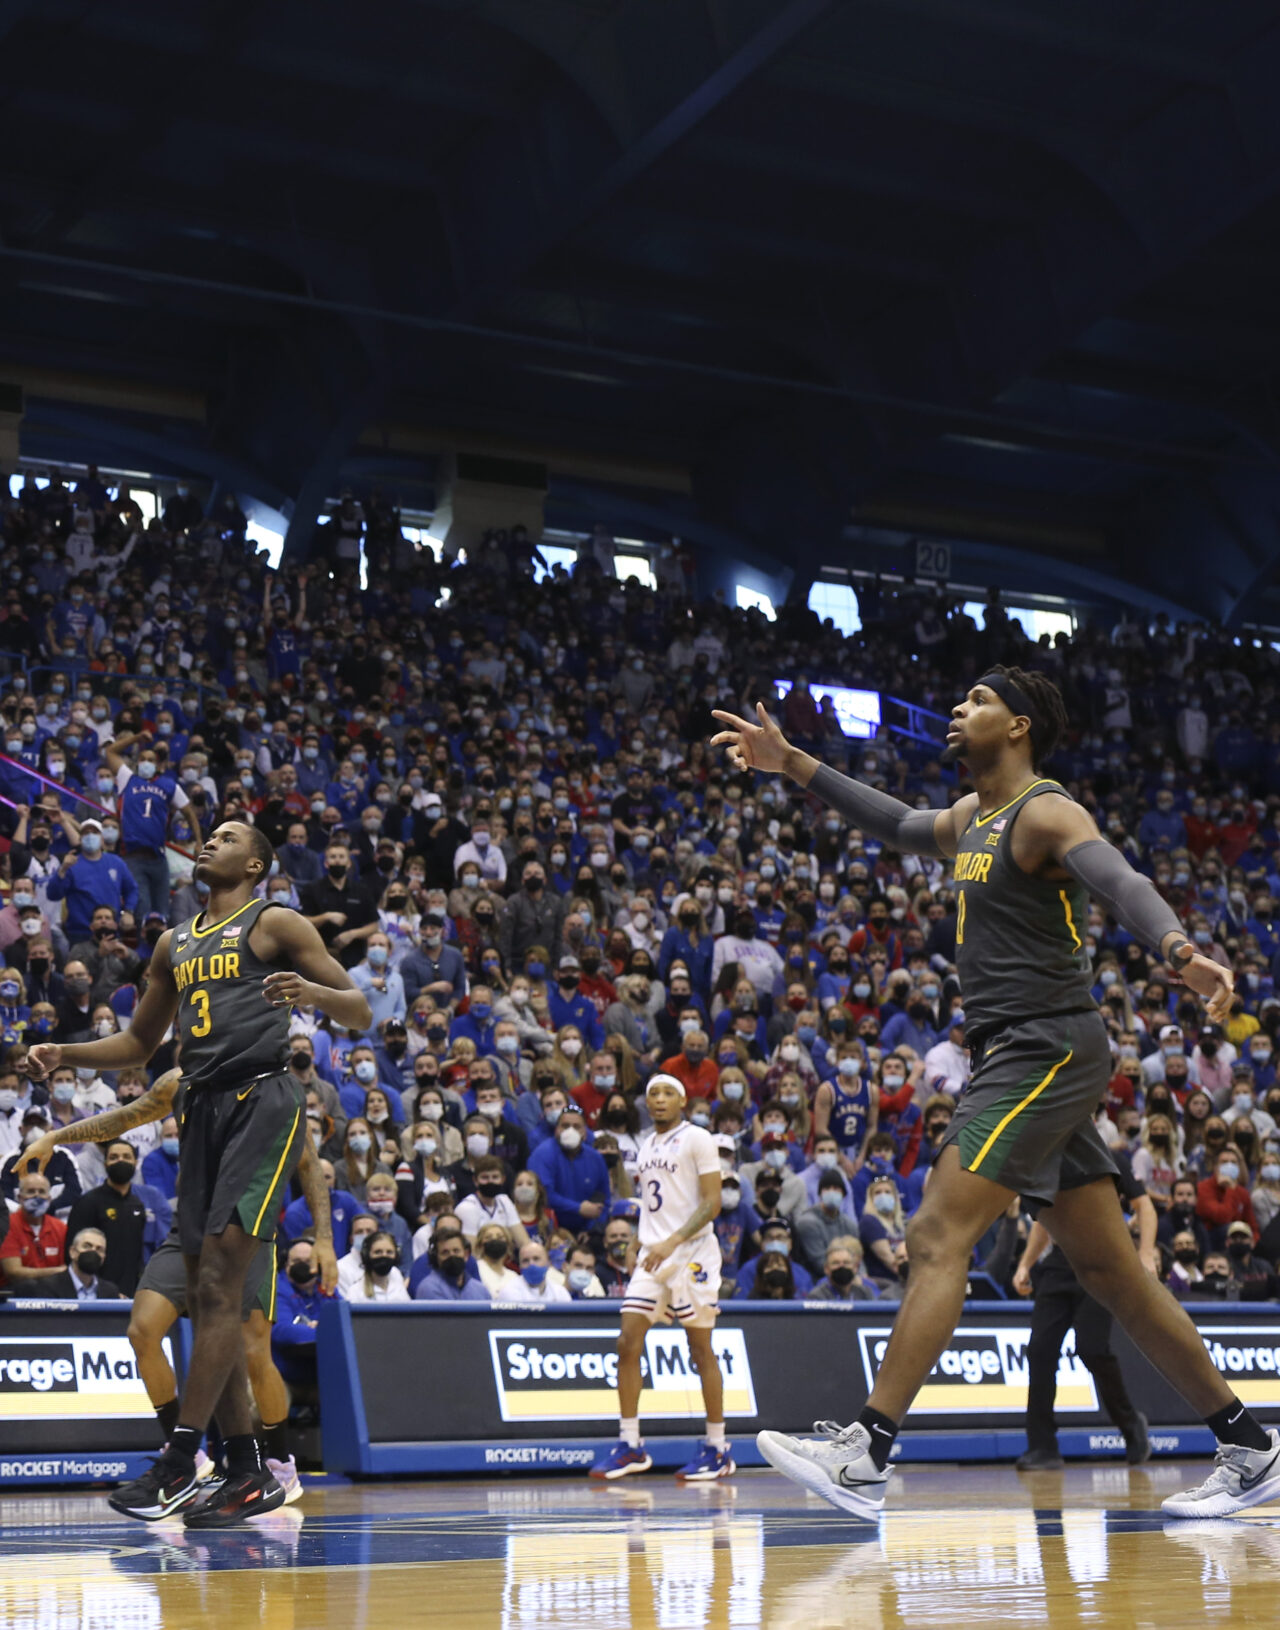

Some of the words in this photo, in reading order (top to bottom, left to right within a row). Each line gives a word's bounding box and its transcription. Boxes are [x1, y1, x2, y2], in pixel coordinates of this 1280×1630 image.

[919, 545, 946, 574] 20
[141, 798, 153, 818] 1
[173, 952, 241, 993] BAYLOR
[190, 989, 213, 1038] 3
[844, 1116, 858, 1136] 2
[647, 1179, 663, 1213] 3
[655, 1344, 734, 1376] Mt
[1089, 1435, 1126, 1450] ROCK
[485, 1448, 539, 1463] ROCKET
[539, 1447, 595, 1465] Mortgage
[0, 1461, 62, 1477] ROCKET
[63, 1460, 127, 1478] Mortgage
